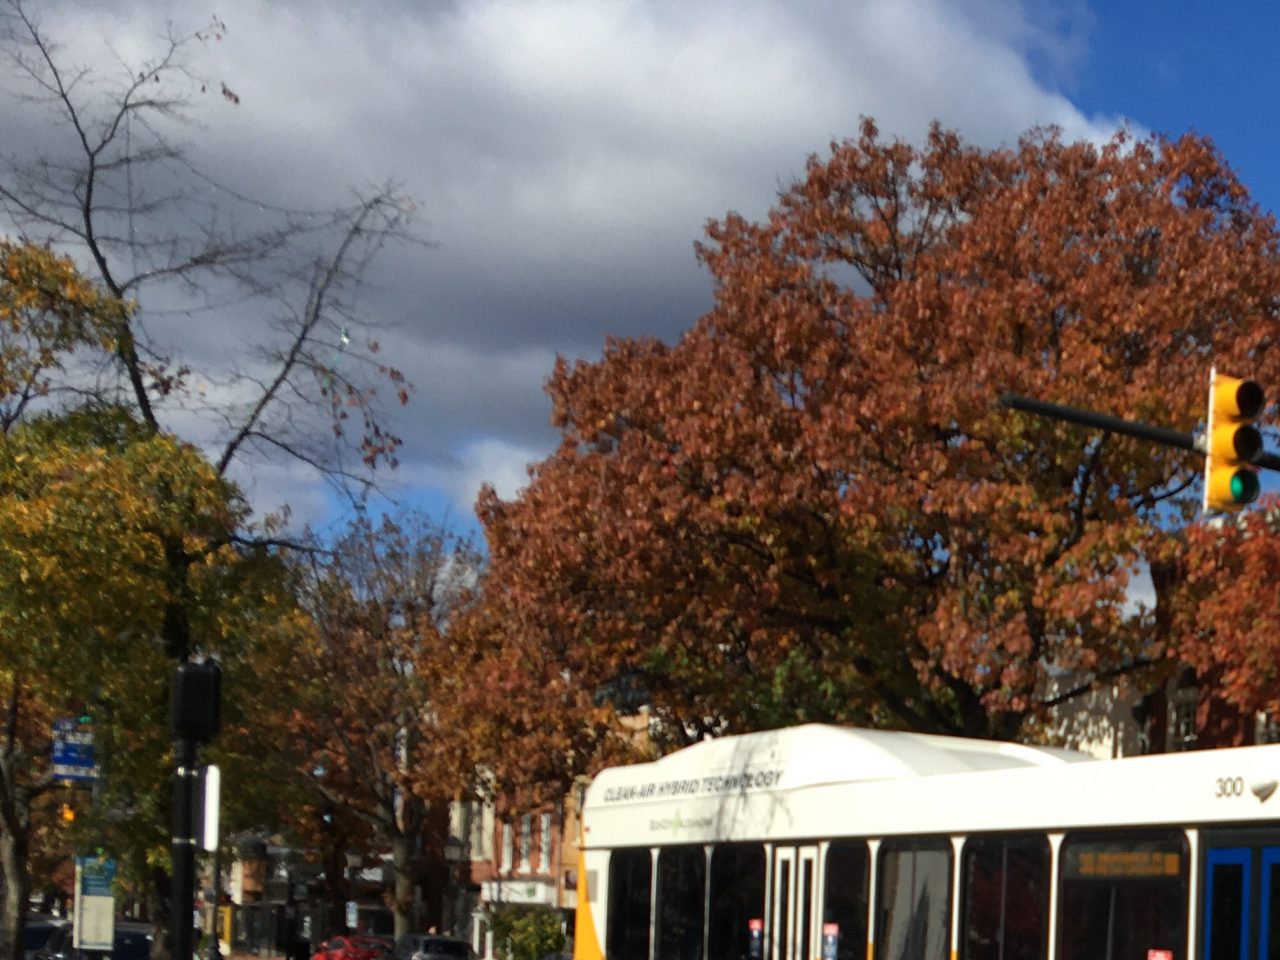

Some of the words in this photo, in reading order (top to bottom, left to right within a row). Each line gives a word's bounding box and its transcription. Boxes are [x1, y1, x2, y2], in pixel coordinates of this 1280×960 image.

[657, 781, 699, 797] HYBRID
[700, 769, 784, 792] TECHNOLOGY
[1215, 775, 1245, 798] 300
